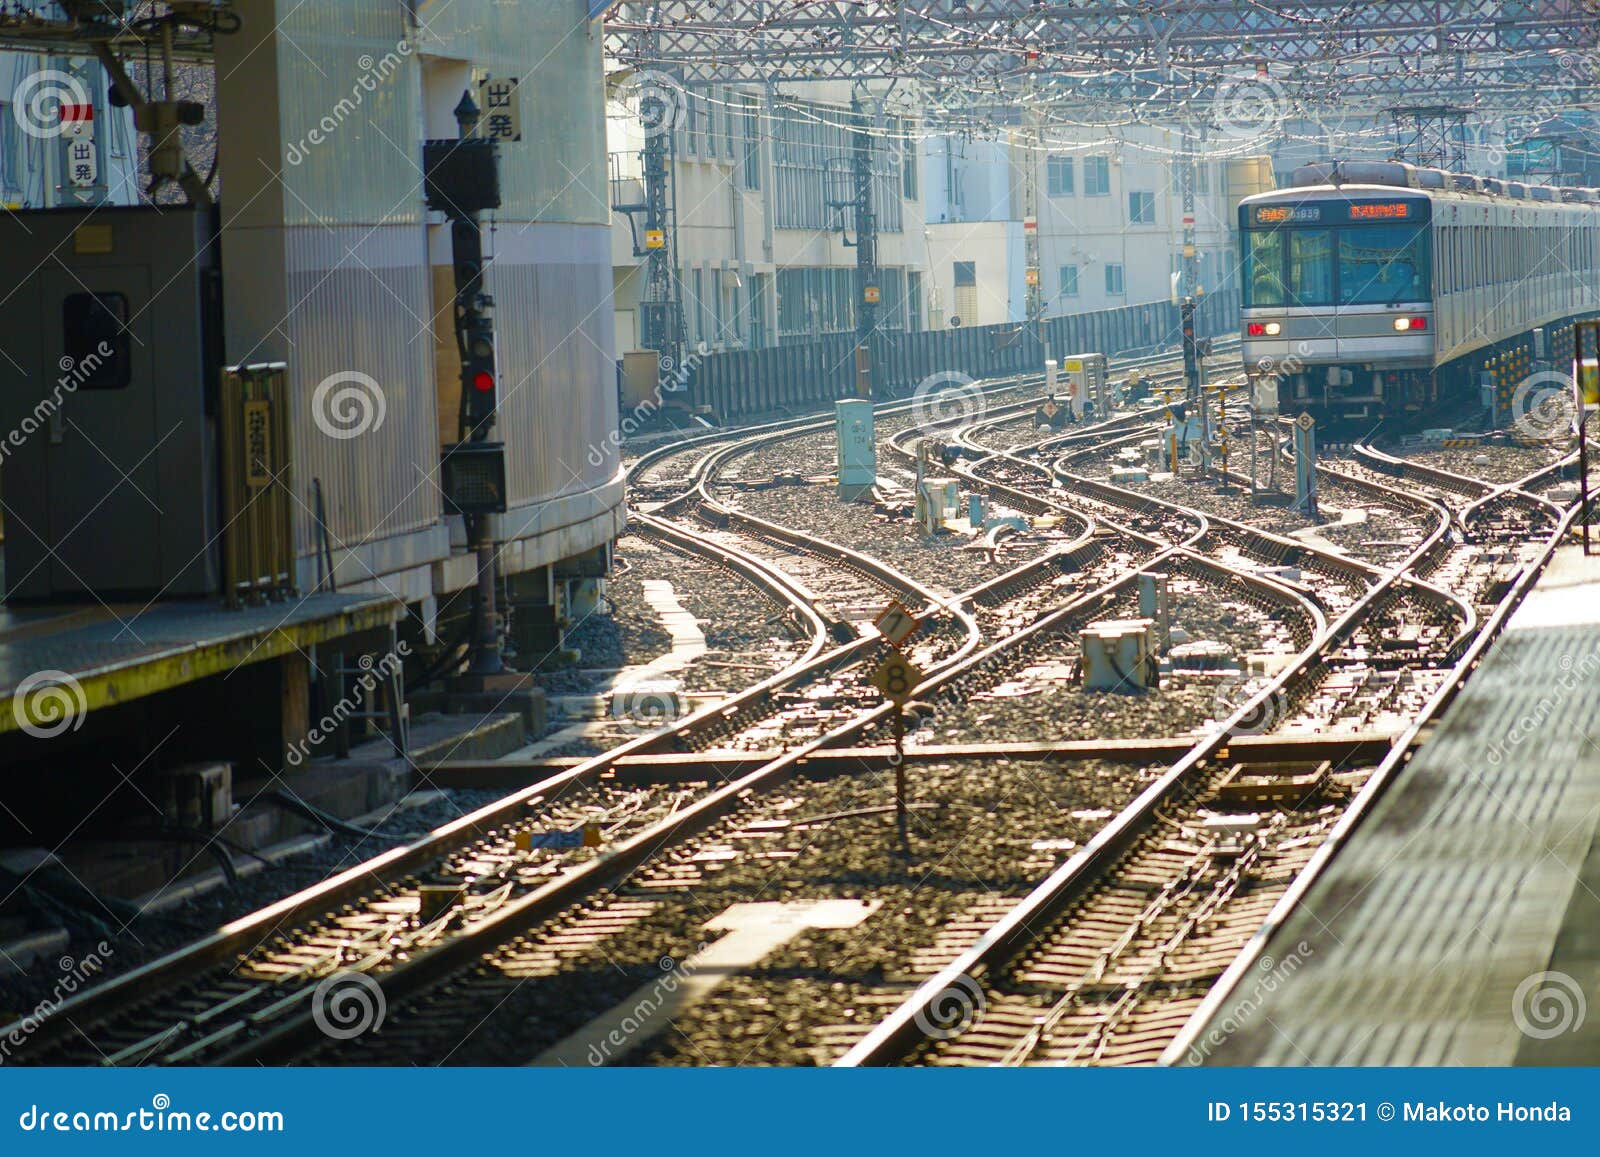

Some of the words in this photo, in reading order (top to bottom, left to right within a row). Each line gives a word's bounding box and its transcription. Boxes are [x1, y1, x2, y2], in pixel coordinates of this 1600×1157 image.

[488, 84, 512, 137] 出発
[74, 144, 91, 179] 出発
[888, 612, 904, 634] 7
[887, 665, 908, 694] 8
